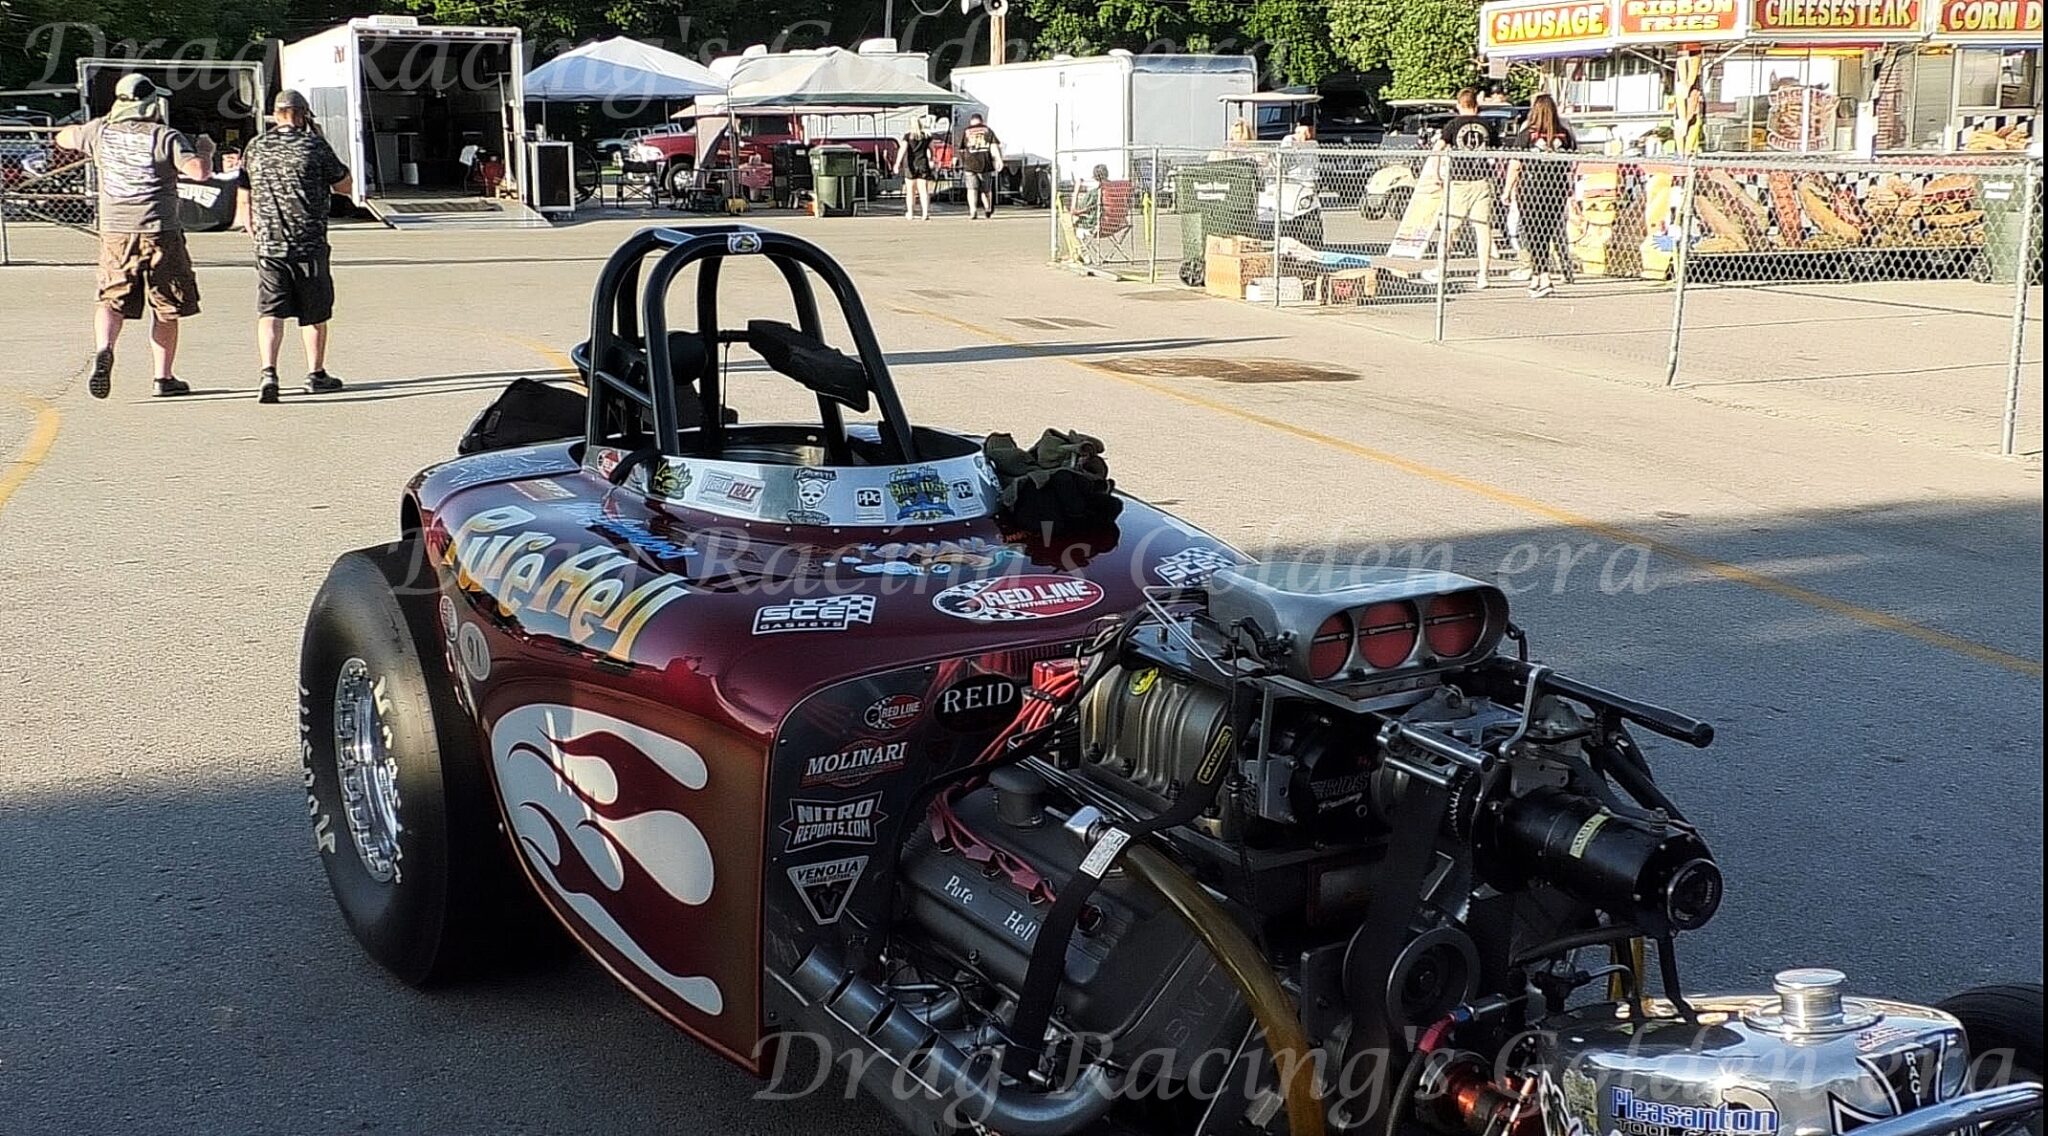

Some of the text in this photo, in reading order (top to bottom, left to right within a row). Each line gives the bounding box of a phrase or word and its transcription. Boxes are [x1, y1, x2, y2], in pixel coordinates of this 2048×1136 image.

[1627, 0, 1734, 16] RIBBON
[1765, 0, 1914, 26] CHEESESTEAK
[1950, 0, 2018, 30] CORN
[1496, 5, 1604, 41] SAUSAGE
[1639, 15, 1721, 31] FRIES
[858, 490, 881, 506] PPG
[1160, 558, 1219, 580] SCE
[443, 505, 692, 662] Pure Hell
[981, 580, 1093, 607] RED LINE
[761, 606, 846, 621] SCE
[1008, 598, 1065, 609] SYNTHETIC
[760, 621, 842, 630] GASKETS
[882, 701, 921, 718] RED LINE
[942, 682, 1014, 714] REID
[805, 742, 908, 776] MOLINARI
[798, 799, 874, 824] NITRO
[793, 819, 871, 846] REPORTS.COM
[797, 861, 858, 881] VENOLIA
[944, 875, 1037, 942] Pure Hell
[1904, 1051, 1922, 1107] RACI
[1611, 1086, 1779, 1132] Pleasanton
